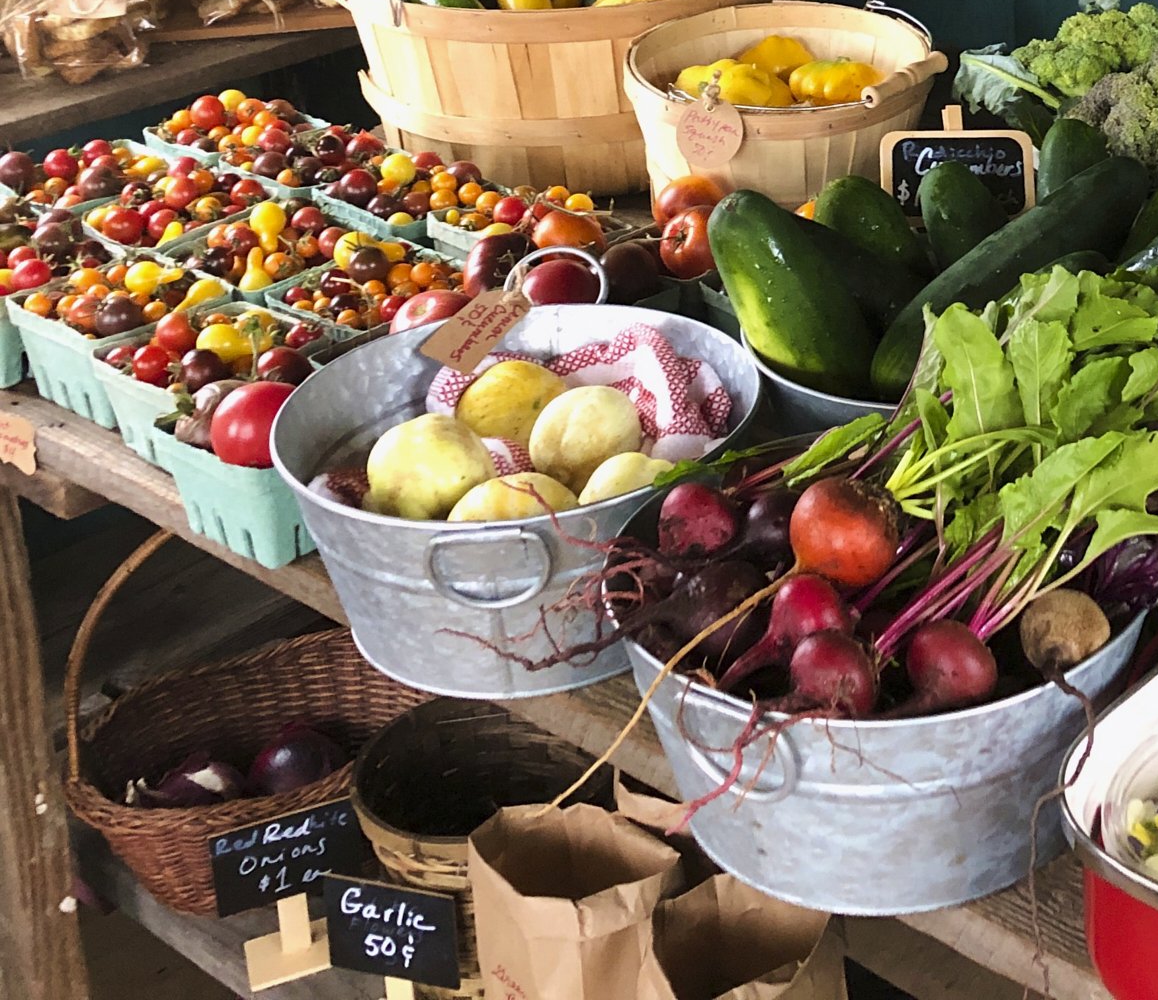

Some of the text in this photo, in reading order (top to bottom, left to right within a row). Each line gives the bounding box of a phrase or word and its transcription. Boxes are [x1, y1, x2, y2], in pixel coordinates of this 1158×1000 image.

[914, 147, 1022, 176] Cmbers
[239, 836, 326, 875] Onions
[339, 886, 436, 932] Garlic
[363, 933, 416, 969] 50¢
